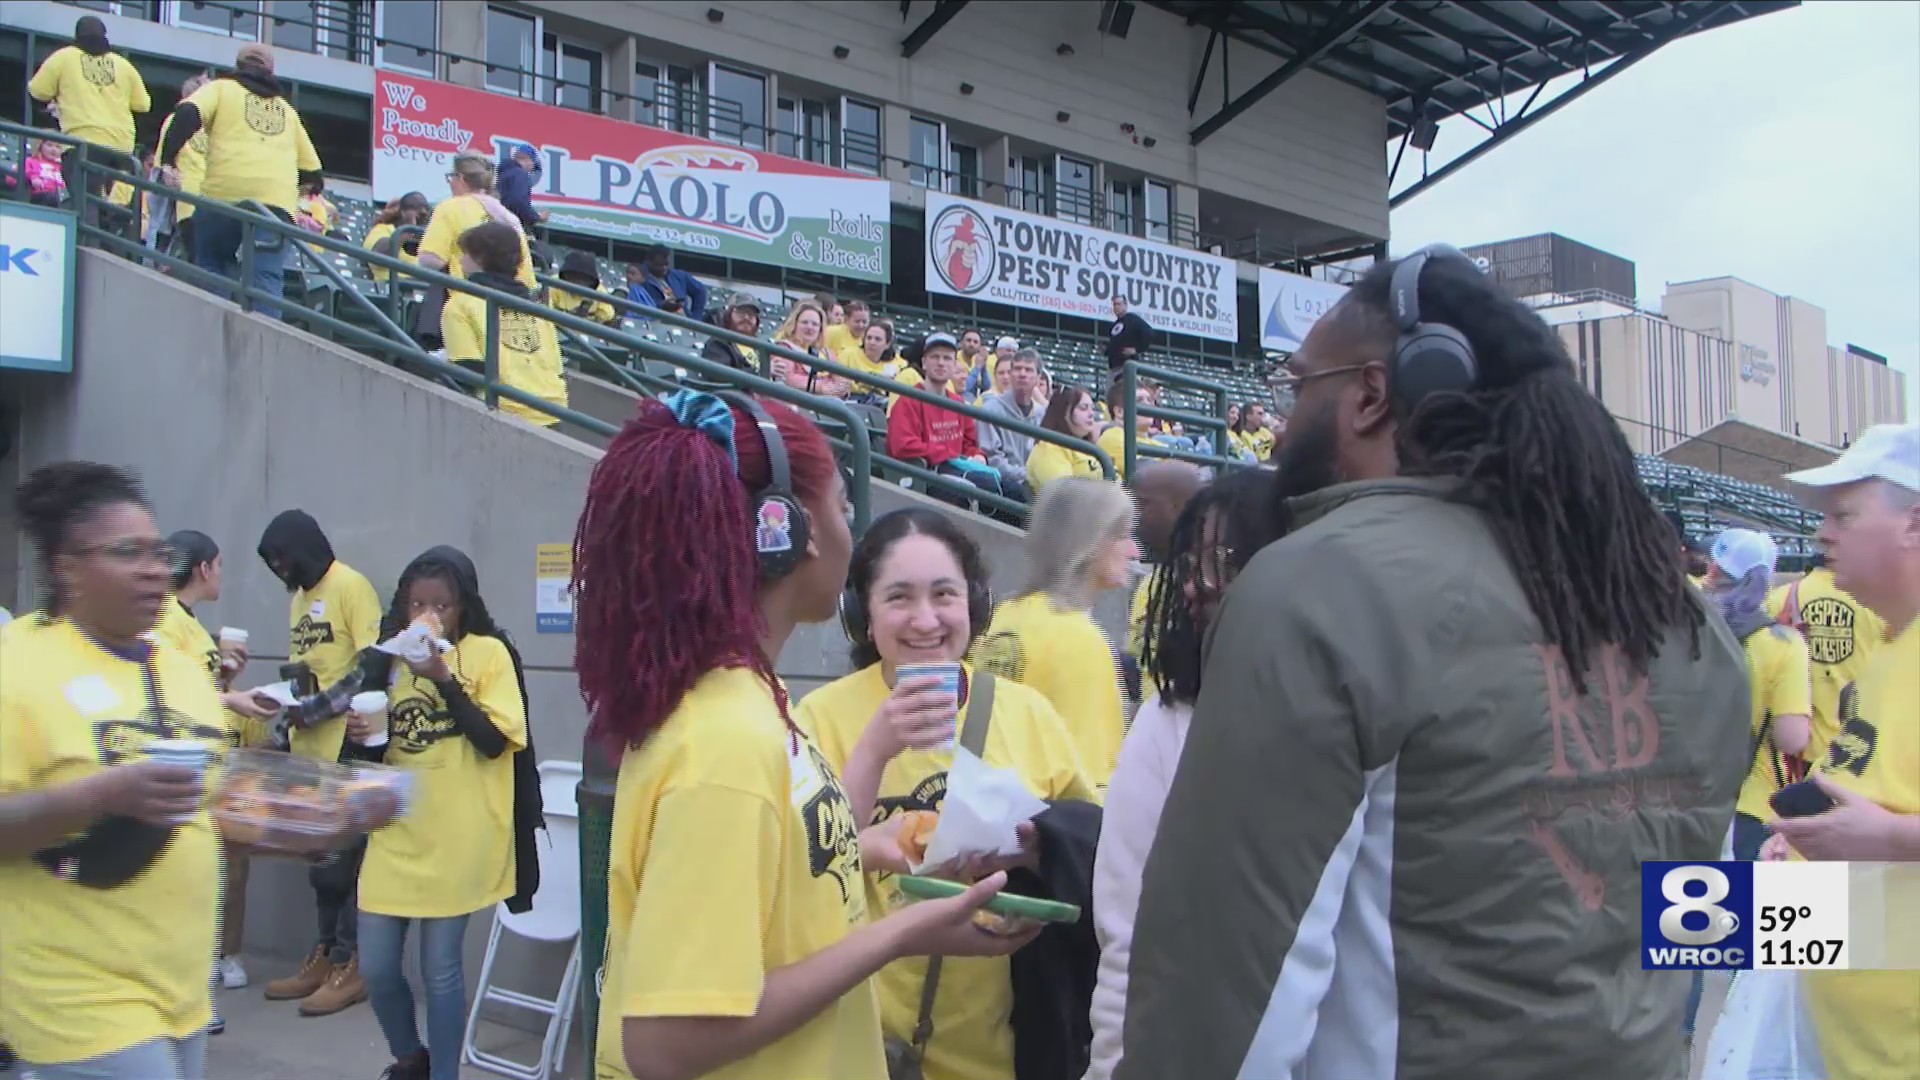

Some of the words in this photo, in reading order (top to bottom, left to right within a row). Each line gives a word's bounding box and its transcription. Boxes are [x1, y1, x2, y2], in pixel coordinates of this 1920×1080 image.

[384, 82, 426, 110] We
[384, 109, 473, 151] Proudly
[384, 135, 446, 165] Serve
[595, 158, 785, 235] PAOLO
[829, 208, 884, 241] Rolls
[790, 232, 813, 261] &
[821, 239, 882, 273] Bread
[993, 216, 1083, 263] TOWN
[1085, 236, 1101, 267] &
[1103, 241, 1221, 291] COUNTRY
[989, 286, 1040, 304] CALL/TEXT
[998, 251, 1070, 293] PEST
[1077, 267, 1217, 320] SOLUTIONS
